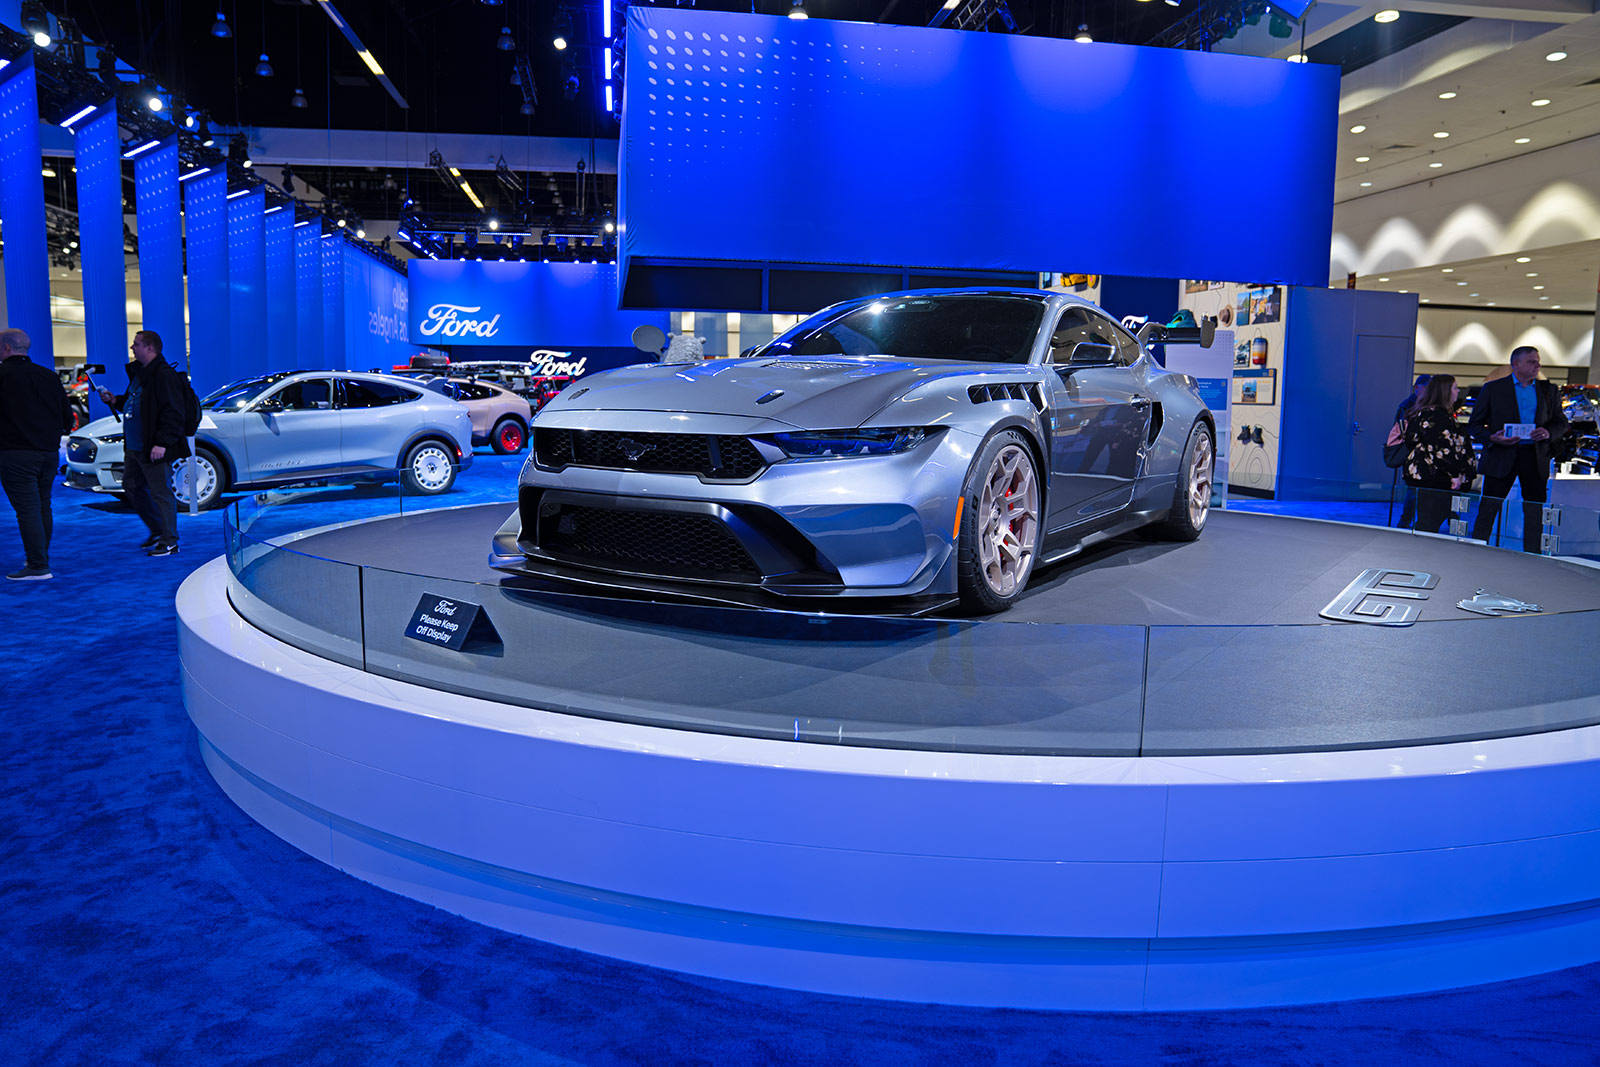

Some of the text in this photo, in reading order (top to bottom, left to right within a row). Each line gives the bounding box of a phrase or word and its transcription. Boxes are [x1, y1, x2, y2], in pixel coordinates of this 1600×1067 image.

[420, 303, 500, 338] Ford
[528, 349, 587, 377] Ford
[434, 600, 457, 616] Ford
[419, 614, 459, 632] Please Keep
[416, 625, 451, 643] Off Display
